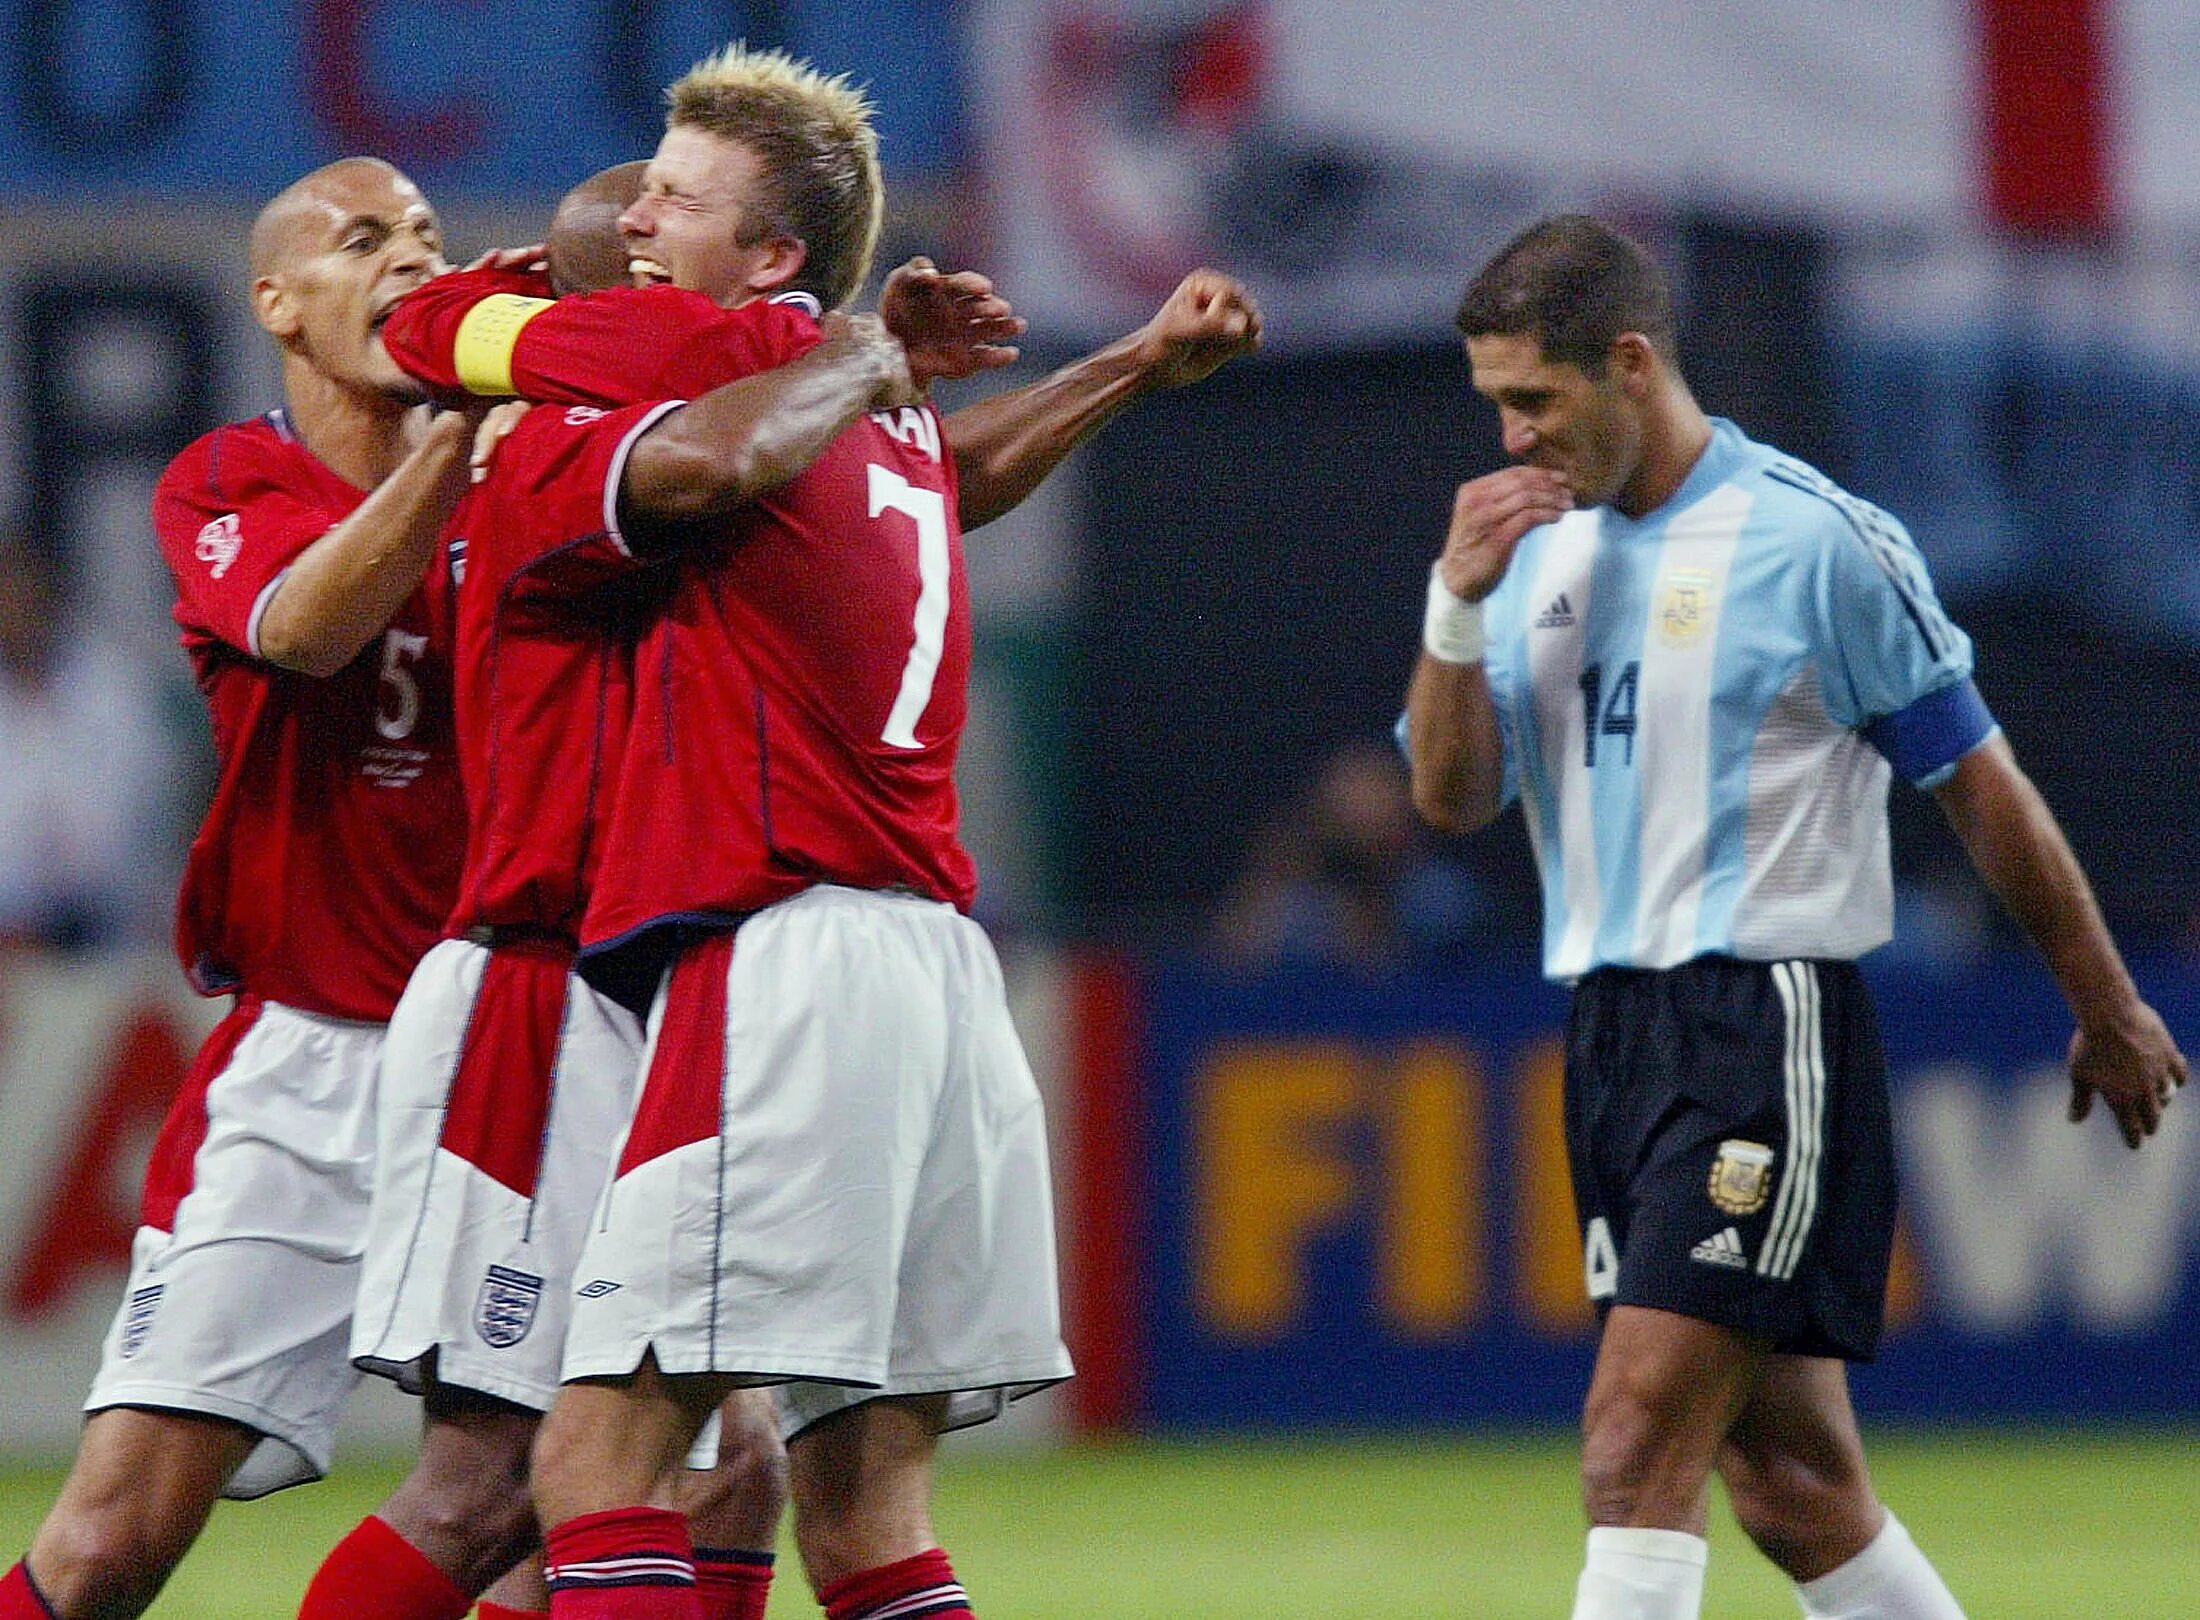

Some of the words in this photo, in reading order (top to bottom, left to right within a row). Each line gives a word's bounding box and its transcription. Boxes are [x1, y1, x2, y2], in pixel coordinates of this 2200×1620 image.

[866, 462, 950, 749] 7
[376, 629, 429, 740] 5
[1578, 660, 1641, 768] 14
